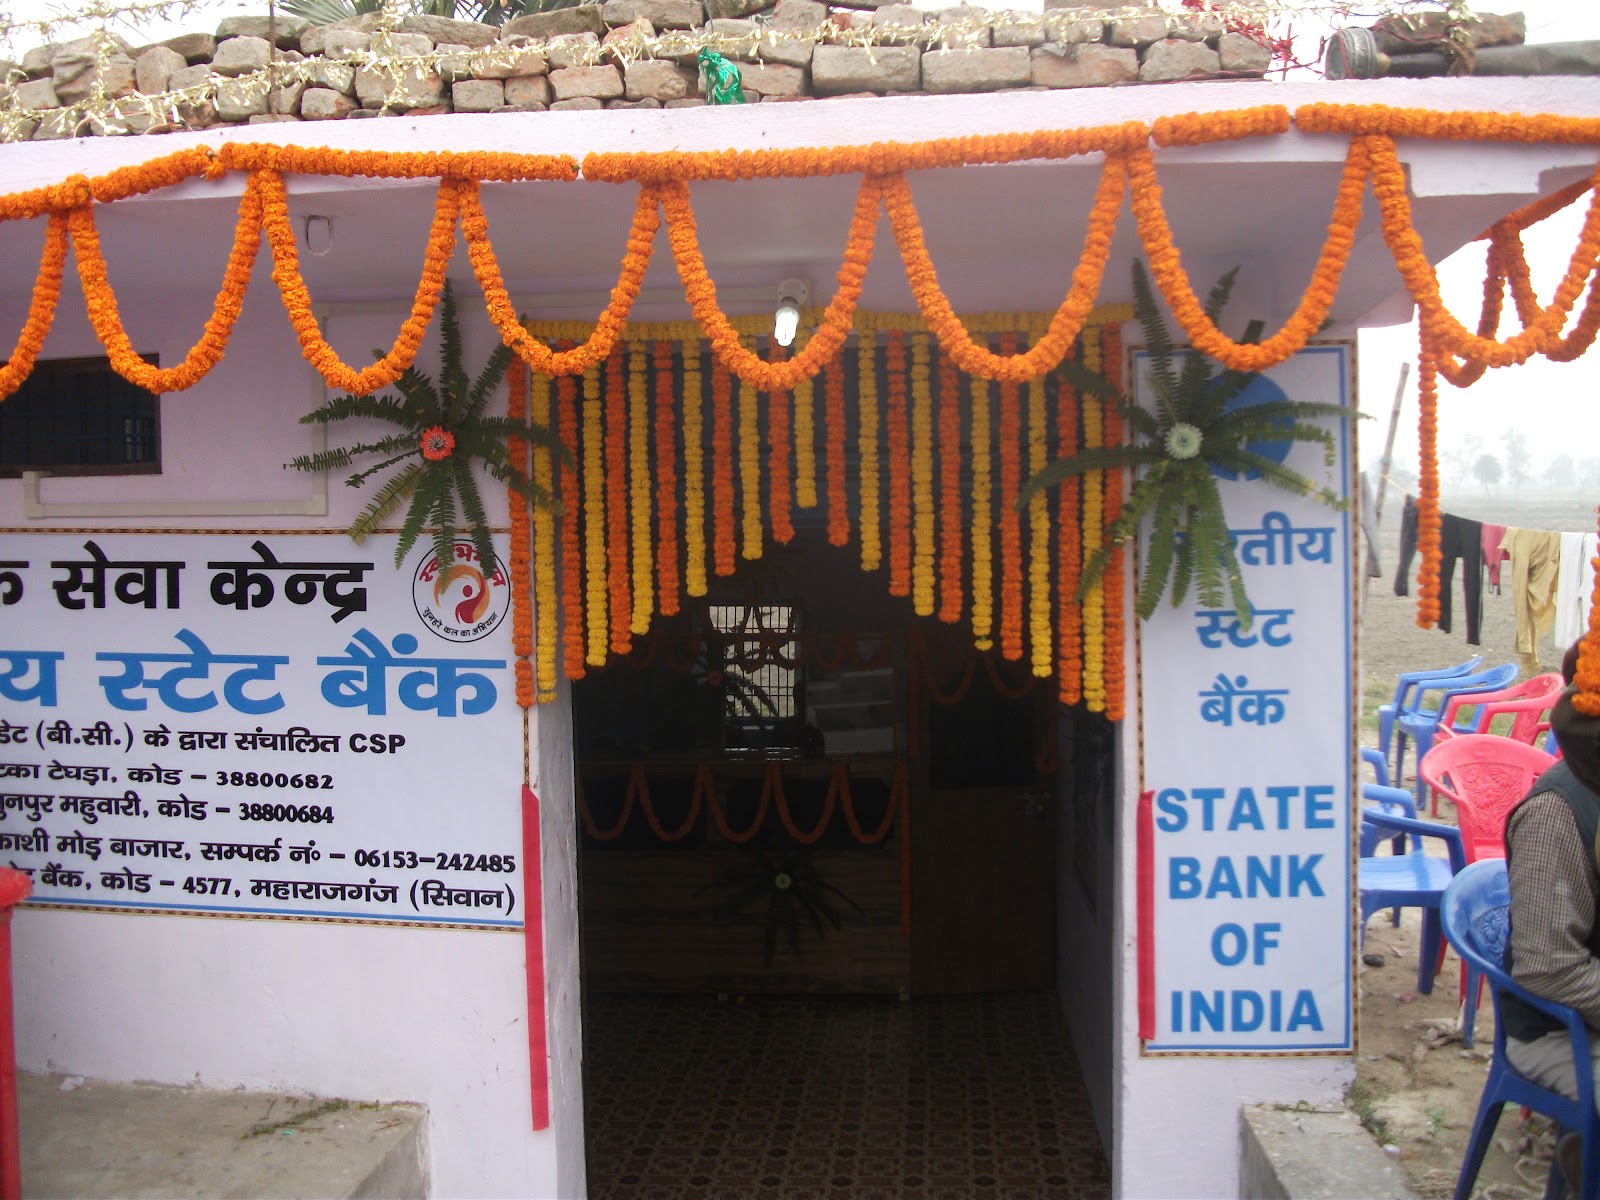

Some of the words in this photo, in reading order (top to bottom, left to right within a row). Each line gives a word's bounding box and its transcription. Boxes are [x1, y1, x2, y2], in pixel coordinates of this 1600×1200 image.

[51, 540, 185, 609] सेवा
[207, 540, 374, 623] केन्द्र
[472, 612, 498, 636] अभियान
[96, 628, 289, 714] स्टेट
[317, 627, 506, 718] बैंक
[1198, 673, 1289, 727] बैंक
[143, 724, 171, 748] के
[178, 731, 228, 751] द्वारा
[234, 726, 341, 753] संचालित
[349, 733, 406, 754] CSP
[127, 763, 182, 785] कोड
[216, 771, 334, 790] 38800682
[157, 793, 208, 820] कोड
[239, 803, 334, 825] 38800684
[1155, 786, 1335, 833] STATE
[110, 838, 191, 861] बाजार,
[200, 838, 282, 863] सम्पर्क
[100, 866, 152, 892] कोड
[182, 876, 241, 897] 4577,
[250, 878, 399, 904] महाराजगंज
[410, 879, 516, 916] (सिवान)
[1168, 853, 1325, 899] BANK
[1210, 922, 1281, 967] OF
[1170, 989, 1324, 1034] INDIA
